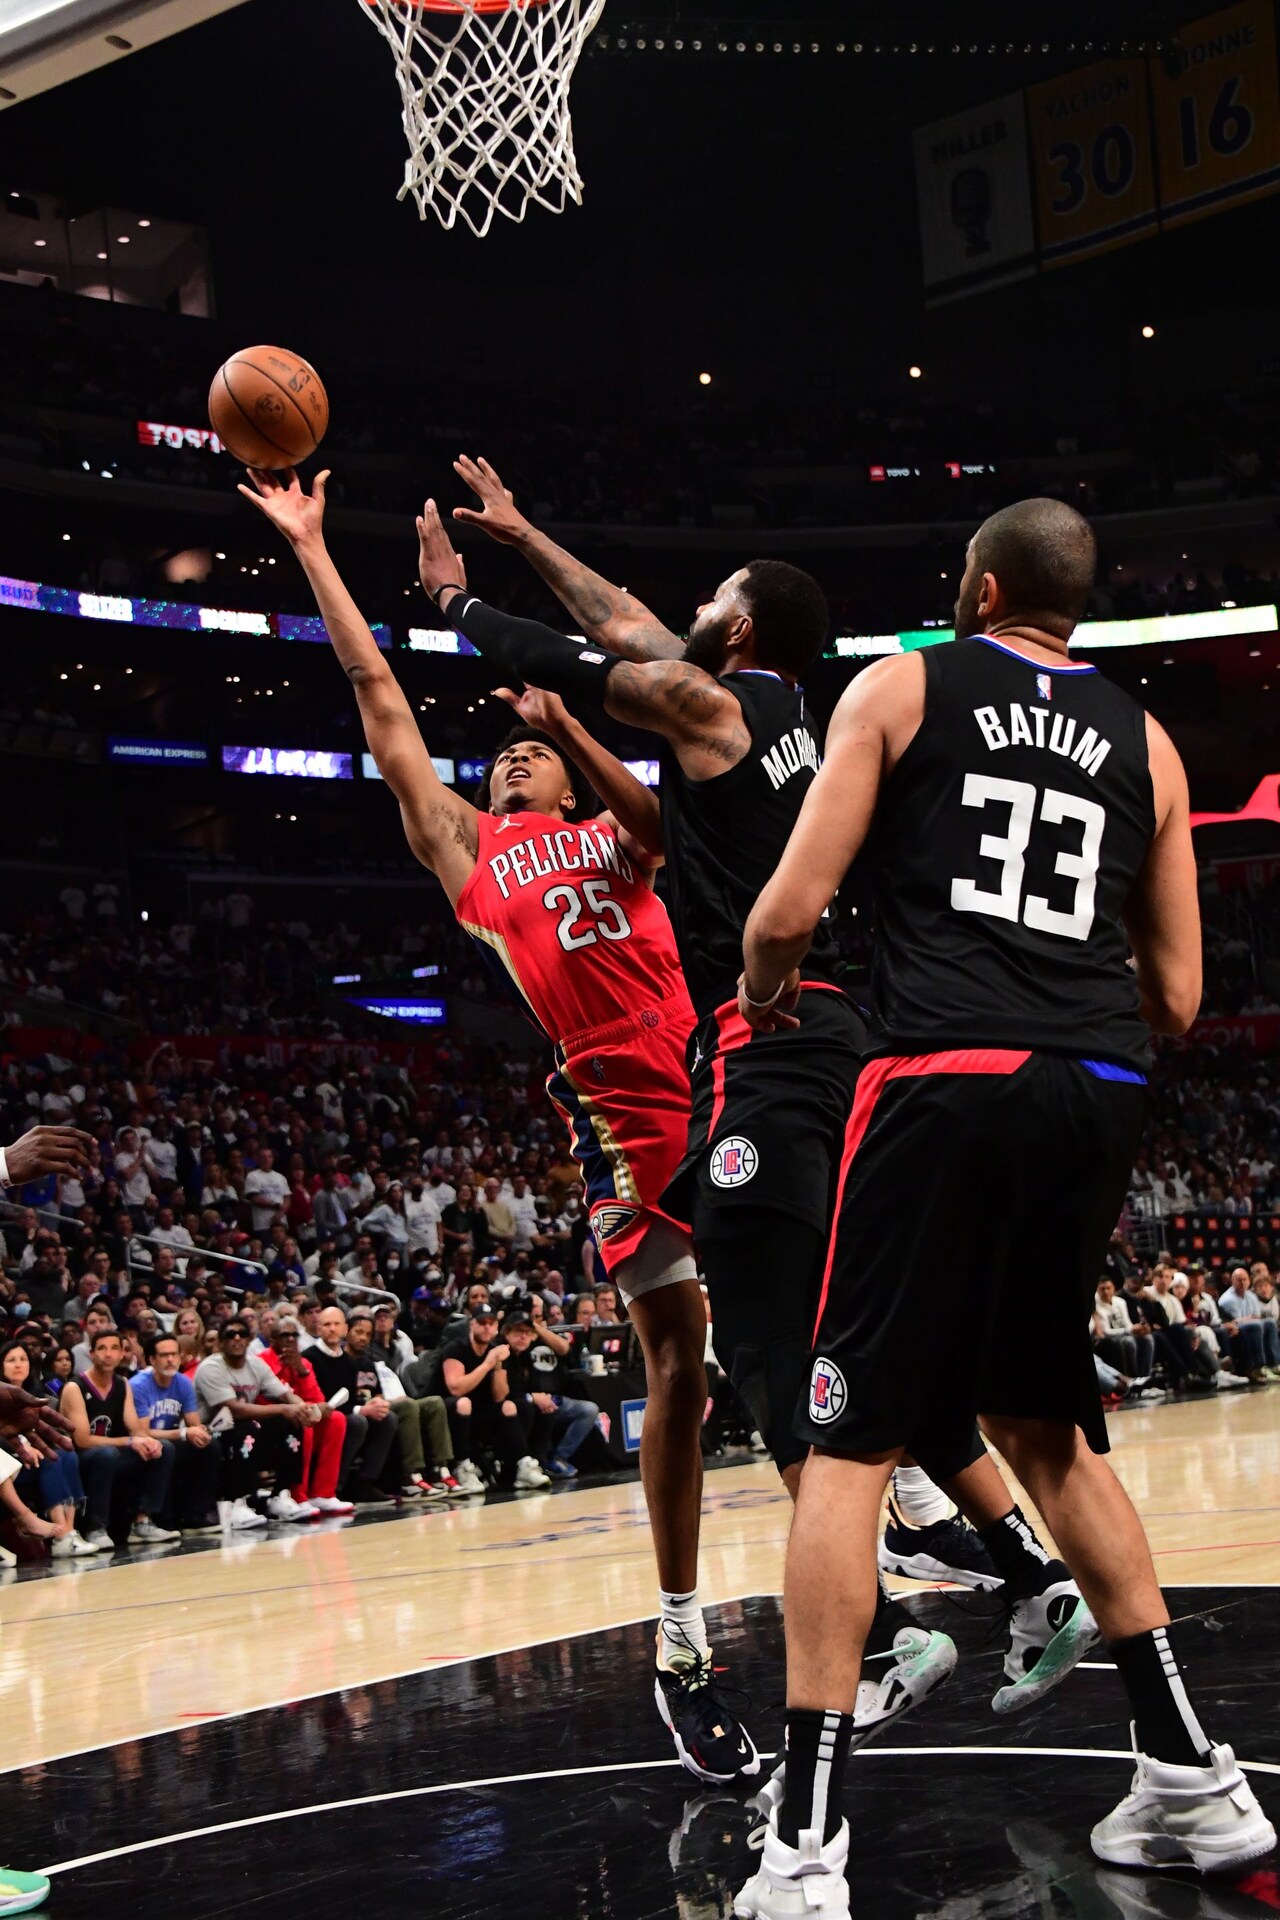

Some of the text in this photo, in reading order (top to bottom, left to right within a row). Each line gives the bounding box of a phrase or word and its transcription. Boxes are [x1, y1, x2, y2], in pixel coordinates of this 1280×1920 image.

[1176, 24, 1257, 70] IONNE
[1045, 74, 1131, 121] VACHON
[1178, 76, 1255, 172] 16
[929, 119, 1008, 164] MILLER
[1047, 124, 1136, 216] 30
[112, 745, 208, 760] AMERICAN EXPRESS
[973, 702, 1113, 778] BATUM
[950, 772, 1107, 942] 33
[542, 879, 633, 953] 25
